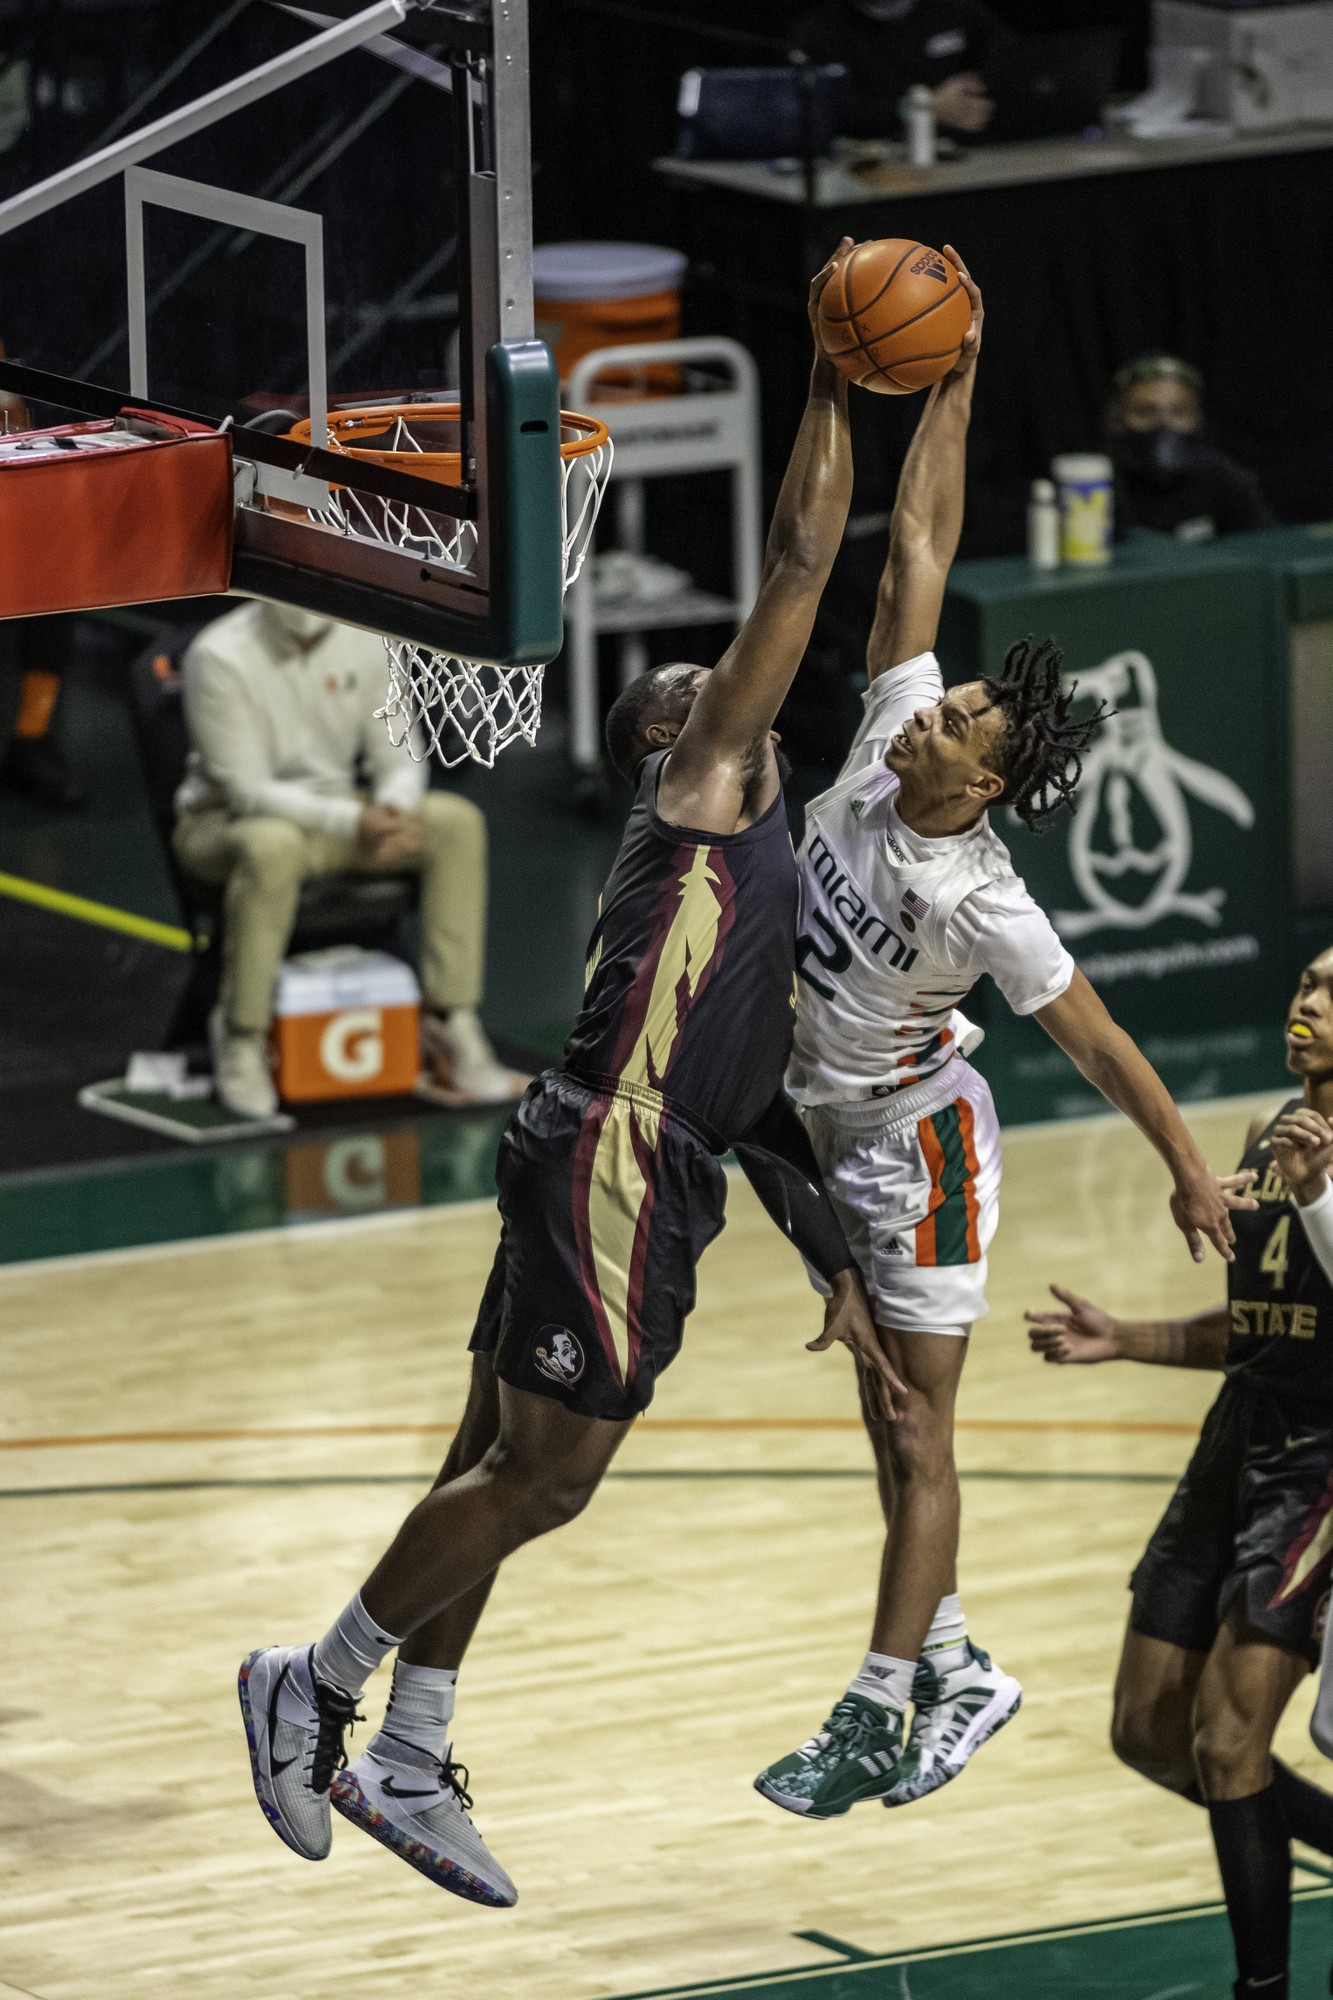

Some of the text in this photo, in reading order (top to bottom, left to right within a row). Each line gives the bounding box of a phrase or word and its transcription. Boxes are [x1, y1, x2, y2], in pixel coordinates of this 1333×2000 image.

[795, 905, 853, 1002] 2
[319, 1008, 385, 1084] G
[1260, 1214, 1292, 1291] 4
[1230, 1299, 1319, 1340] STATE
